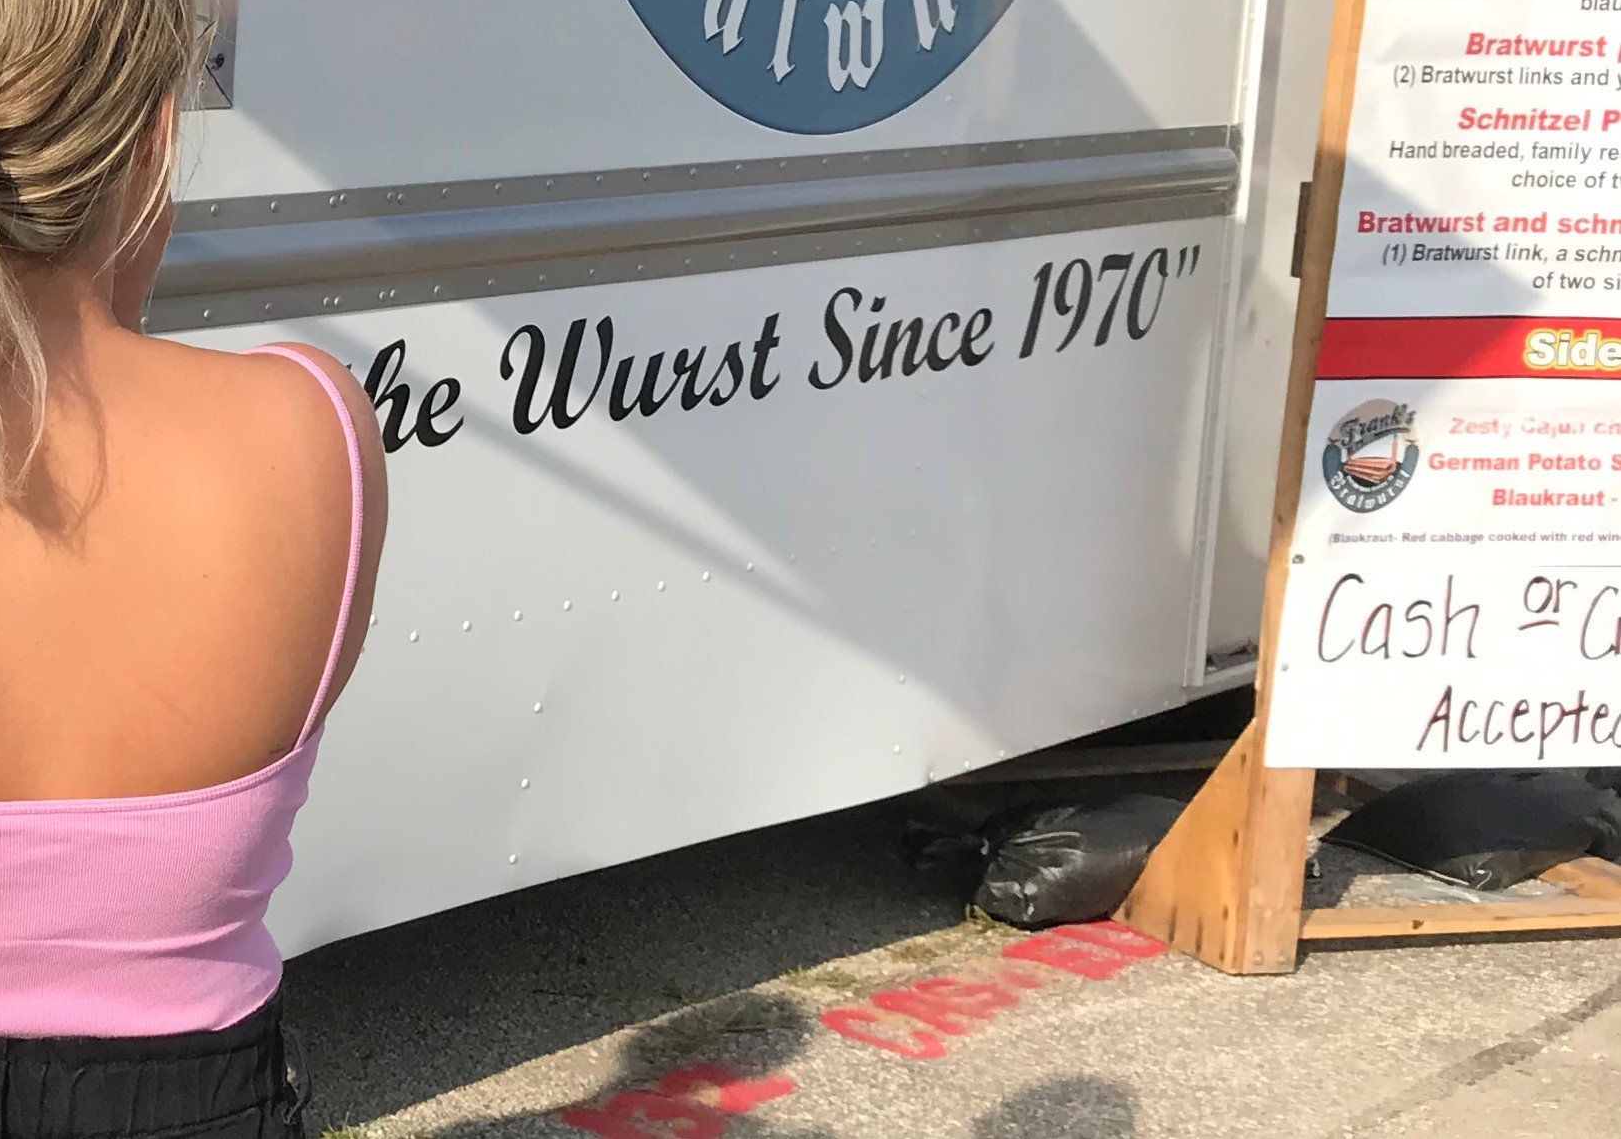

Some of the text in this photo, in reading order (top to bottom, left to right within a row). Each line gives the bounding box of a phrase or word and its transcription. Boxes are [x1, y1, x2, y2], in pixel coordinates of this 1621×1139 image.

[1466, 32, 1607, 58] Bratwurst
[1393, 65, 1416, 89] (2)
[1421, 65, 1513, 86] Bratwurst
[1519, 66, 1563, 85] links
[1570, 68, 1610, 86] and
[1458, 107, 1591, 132] Schnitzel
[1389, 140, 1437, 160] Hand
[1442, 142, 1525, 162] breaded,
[1532, 141, 1592, 165] family
[1511, 170, 1577, 189] choice
[1584, 171, 1607, 189] of
[1357, 211, 1485, 235] Bratwurst
[1493, 212, 1547, 234] and
[1382, 243, 1407, 266] (1)
[1411, 243, 1499, 263] Bratwurst
[1504, 243, 1549, 265] link,
[1555, 248, 1569, 262] a
[1532, 272, 1554, 290] of
[1560, 273, 1596, 290] two
[354, 243, 1201, 455] he Wurst Since 1970"
[1449, 417, 1512, 438] Zesty
[1428, 452, 1520, 471] German
[1528, 453, 1602, 471] Potato
[1492, 488, 1605, 507] Blaukraut
[1401, 532, 1427, 543] Red
[1430, 532, 1484, 545] cabbage
[1488, 531, 1535, 543] cooked
[1540, 531, 1567, 542] with
[1571, 531, 1594, 542] red
[1318, 573, 1480, 663] Cash
[1523, 575, 1578, 614] or
